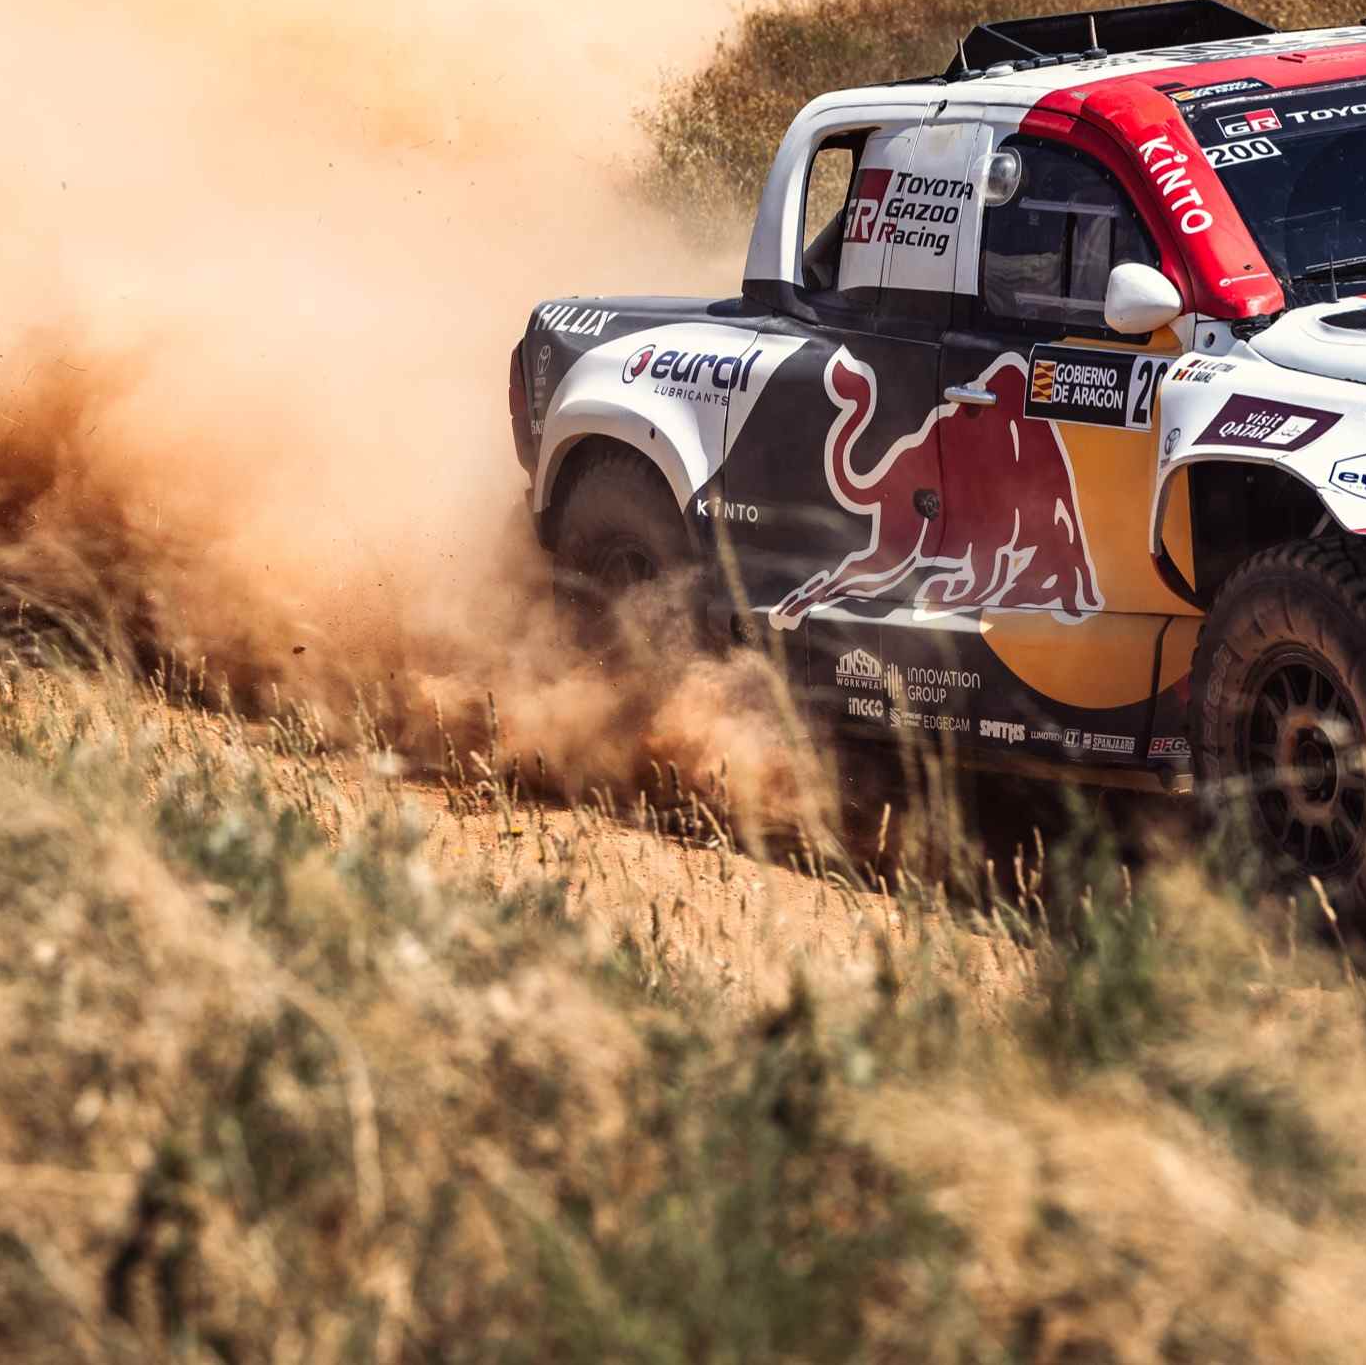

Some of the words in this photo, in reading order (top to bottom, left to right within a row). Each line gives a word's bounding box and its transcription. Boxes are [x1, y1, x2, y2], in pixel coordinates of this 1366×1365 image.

[1224, 115, 1280, 136] GR
[1205, 138, 1275, 167] 200
[895, 171, 974, 200] TOYOTA
[885, 198, 959, 224] GAZOO
[877, 222, 950, 256] Racing
[534, 303, 619, 336] HILUX
[650, 349, 763, 392] eurol
[1055, 363, 1118, 388] GOBIERNO
[654, 384, 730, 407] LUBRICANTS
[1053, 386, 1069, 404] DE
[1071, 387, 1124, 410] ARAGON
[1218, 421, 1273, 440] QATAR
[1246, 409, 1285, 428] visit
[907, 666, 981, 689] INNOVATION
[907, 685, 947, 703] GROUP
[923, 714, 971, 732] EDGECAM
